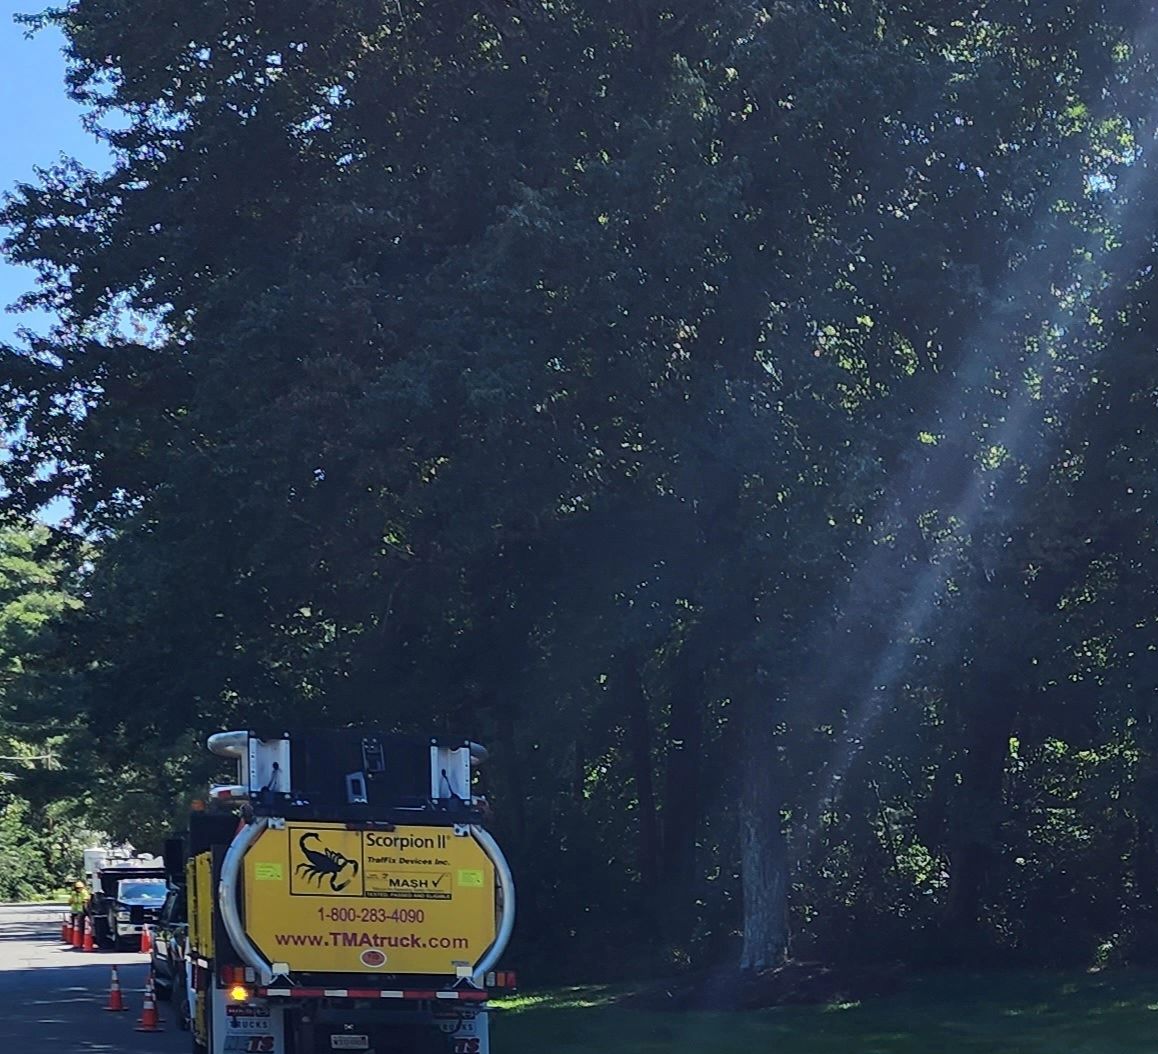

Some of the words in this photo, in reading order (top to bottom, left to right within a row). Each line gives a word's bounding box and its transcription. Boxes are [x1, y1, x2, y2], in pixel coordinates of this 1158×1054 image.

[366, 832, 434, 851] Scorpion
[398, 857, 433, 866] Devices
[434, 858, 451, 866] Inc.
[389, 878, 428, 888] MASH
[318, 906, 425, 923] 1-800-283-4090
[274, 931, 469, 949] www.TMAtruck.com
